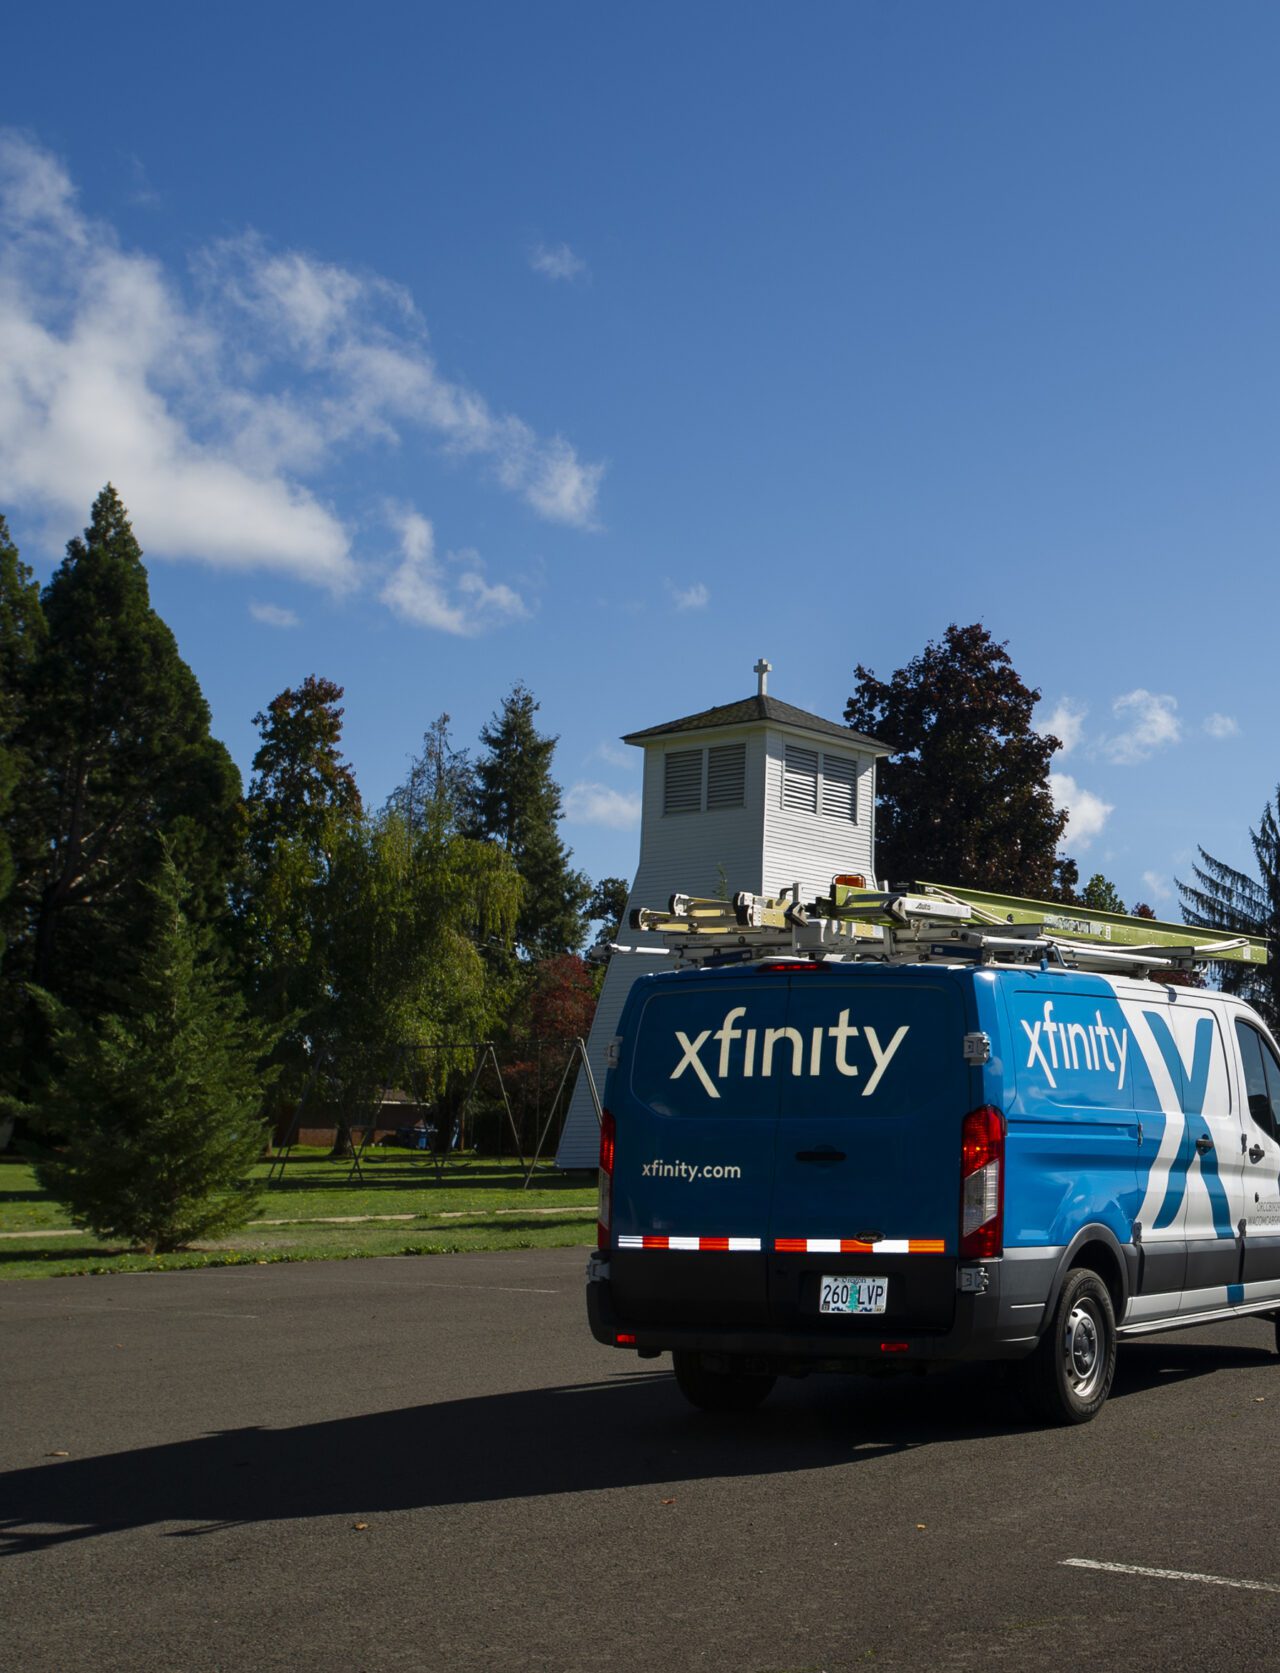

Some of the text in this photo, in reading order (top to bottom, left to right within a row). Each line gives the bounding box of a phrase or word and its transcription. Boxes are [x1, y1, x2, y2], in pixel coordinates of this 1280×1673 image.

[669, 1006, 911, 1099] xfinity
[1020, 1000, 1128, 1090] xfinity
[641, 1159, 741, 1182] xfinity.com
[823, 1284, 884, 1305] 260 LVP
